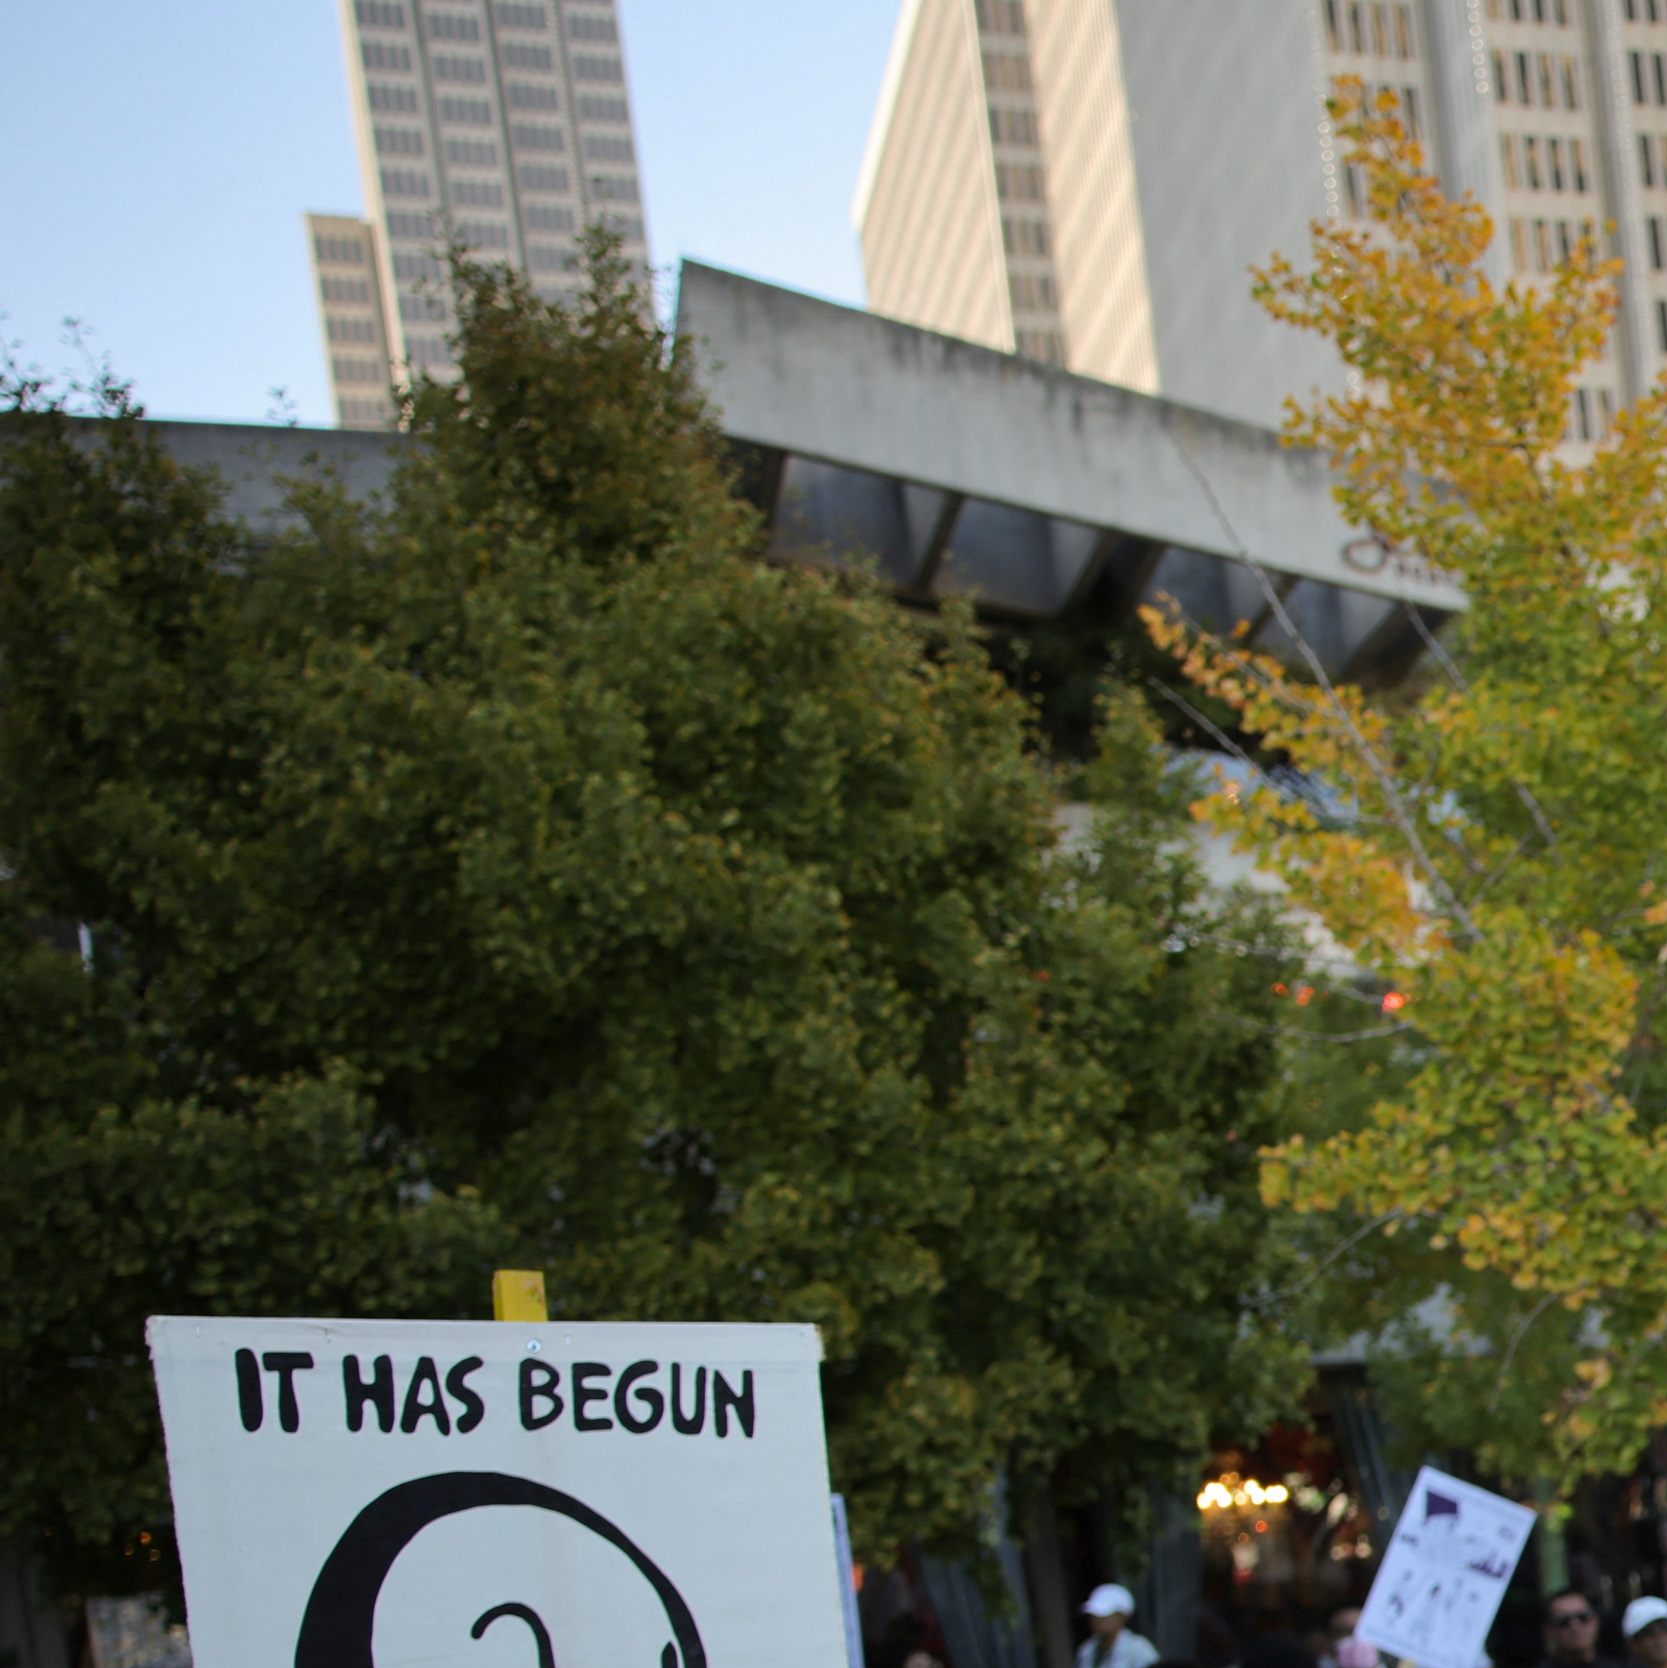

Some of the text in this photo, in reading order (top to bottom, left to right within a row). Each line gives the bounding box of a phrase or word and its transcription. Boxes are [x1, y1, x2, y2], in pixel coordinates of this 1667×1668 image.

[234, 1347, 756, 1440] IT HAS BEGUN
